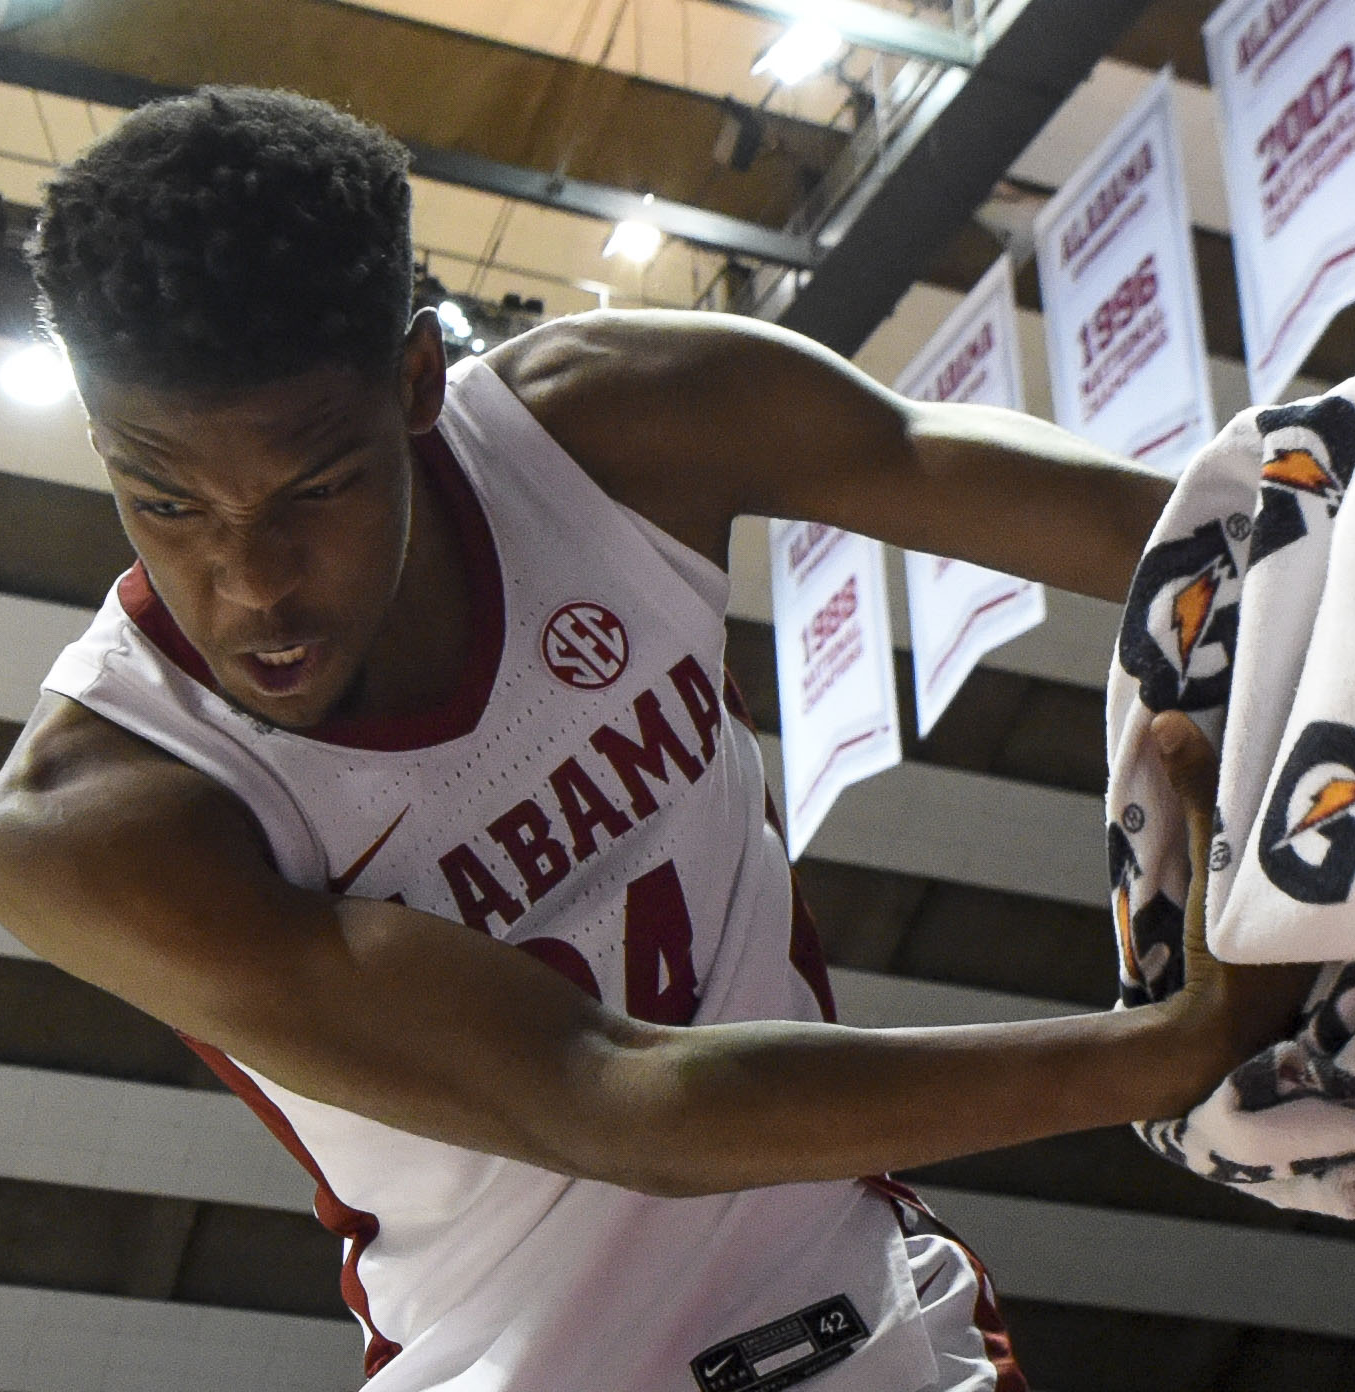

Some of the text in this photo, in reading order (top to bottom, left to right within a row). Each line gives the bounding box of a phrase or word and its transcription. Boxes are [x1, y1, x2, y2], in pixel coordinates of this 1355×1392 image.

[1079, 253, 1158, 368] 1996
[545, 606, 627, 685] SEC
[384, 653, 723, 937] ABAMA
[512, 859, 701, 1029] 4
[818, 1311, 850, 1335] 42
